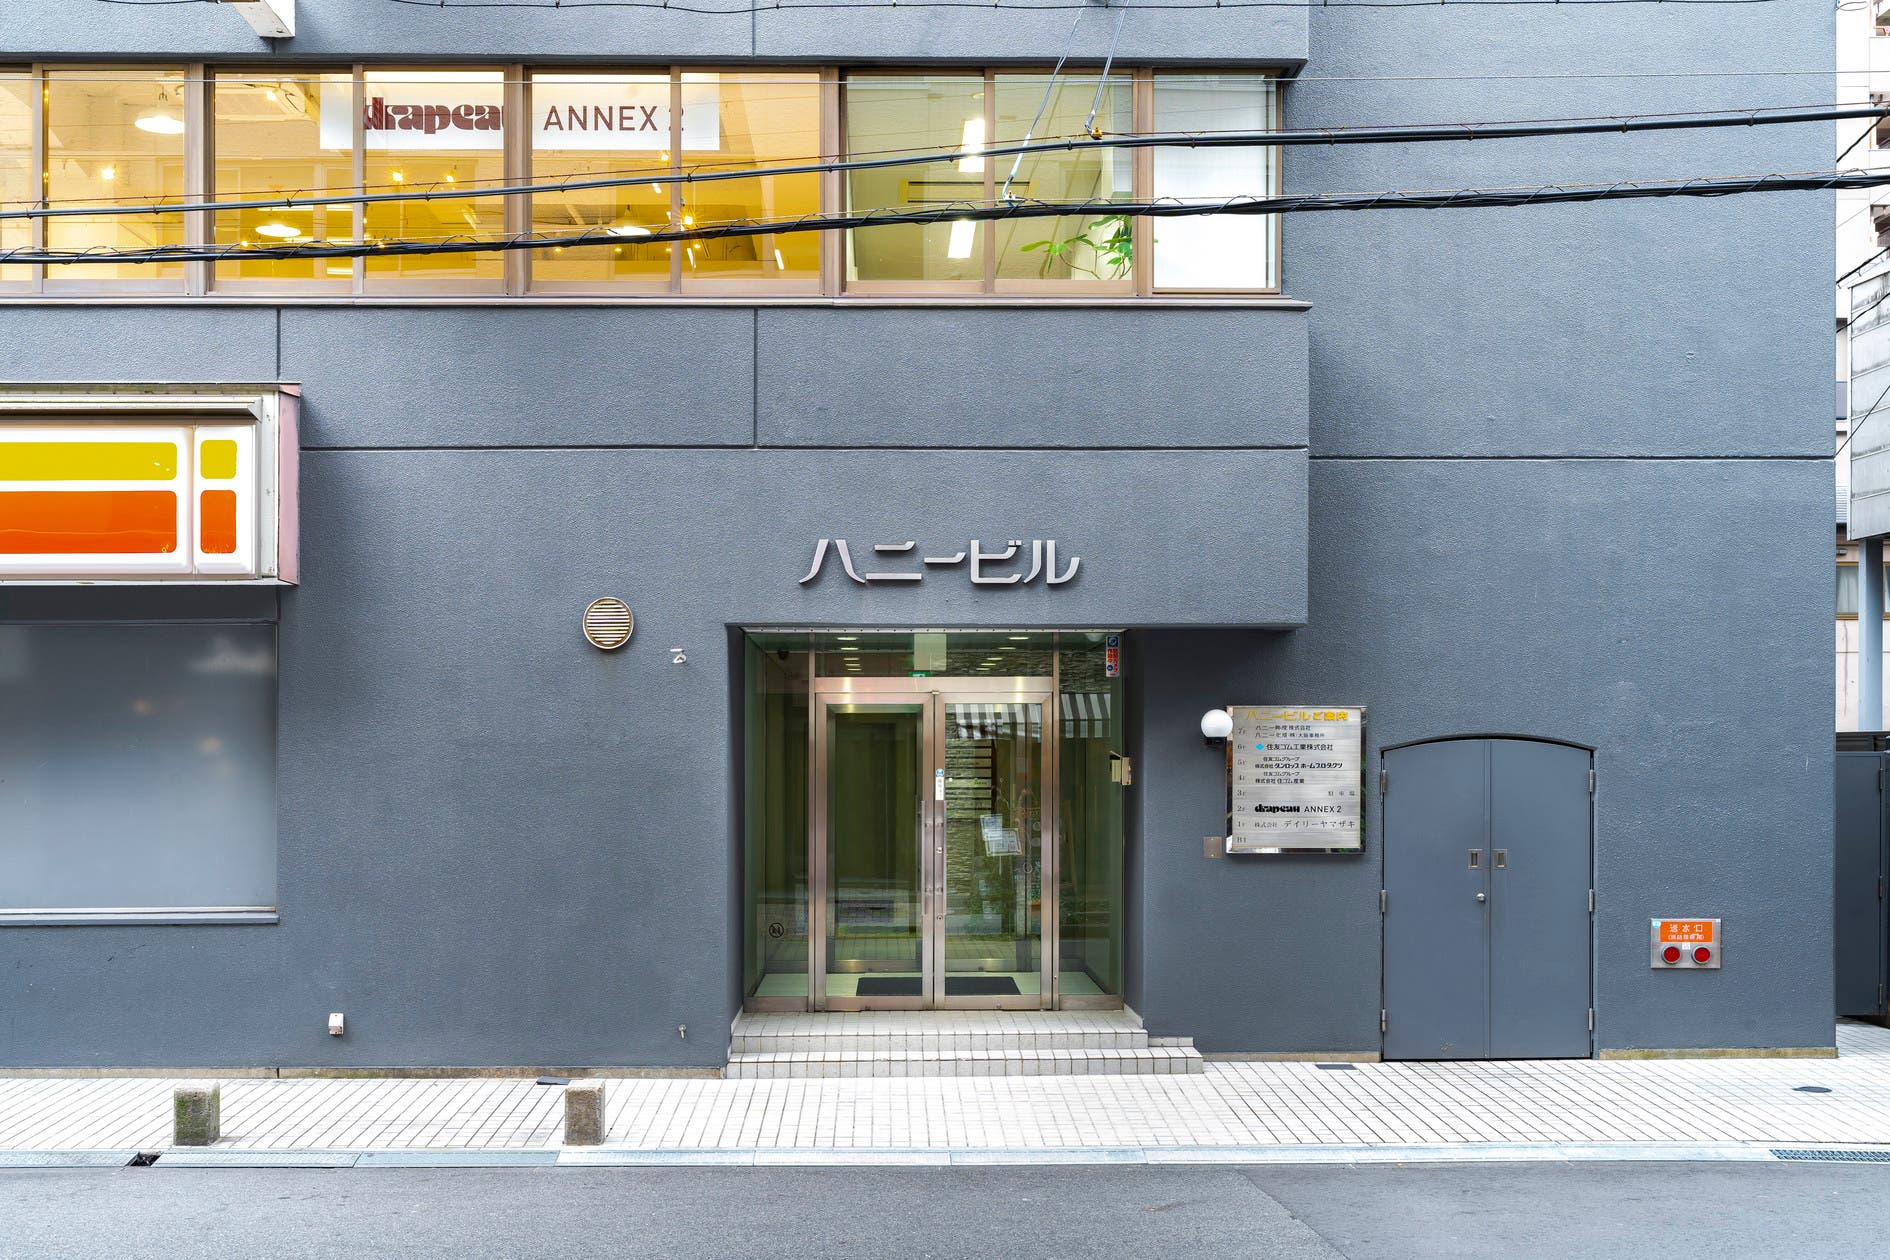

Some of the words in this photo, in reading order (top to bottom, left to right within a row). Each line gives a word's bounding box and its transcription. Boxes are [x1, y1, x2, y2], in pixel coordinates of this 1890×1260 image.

[365, 97, 504, 134] drapea
[544, 105, 658, 131] ANNEX
[799, 538, 1081, 584] ハニービル
[1266, 743, 1333, 751] 住友ゴム工業株式会社
[1254, 804, 1300, 813] drapeau
[1283, 820, 1355, 828] デイリーヤマザキ
